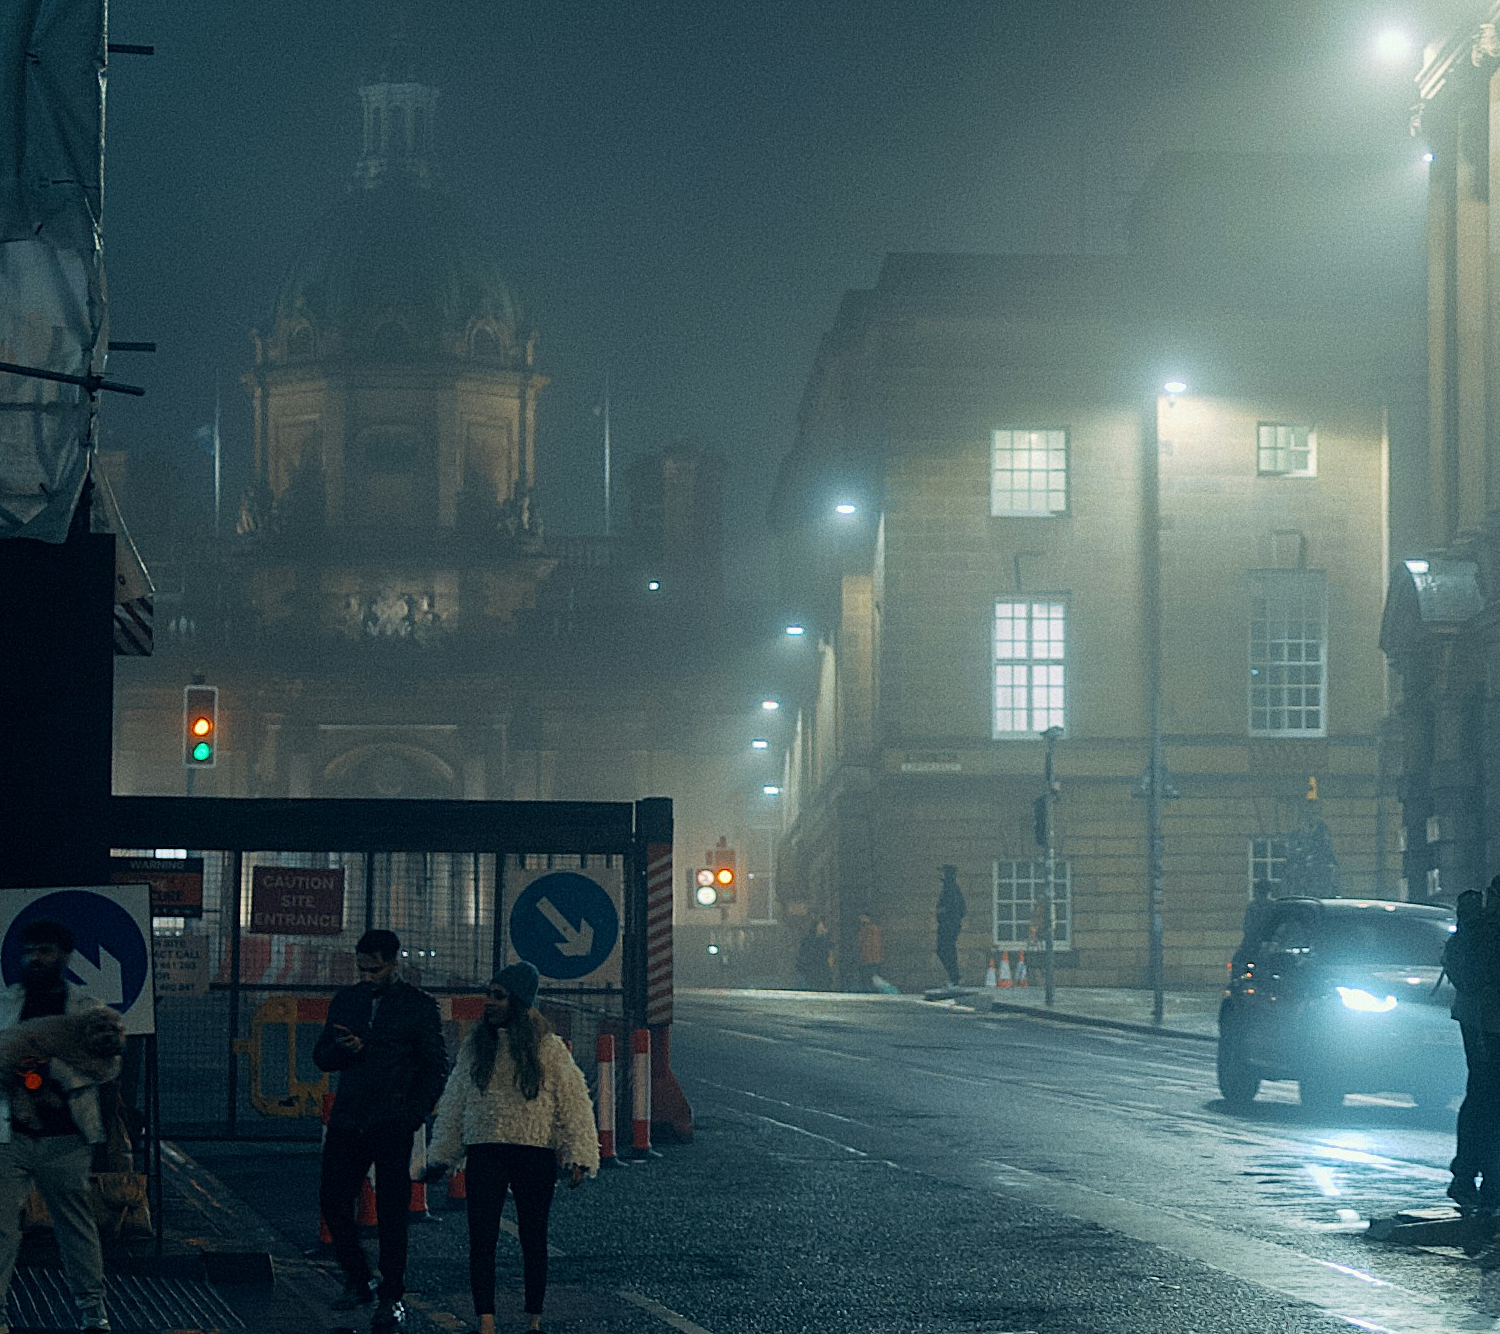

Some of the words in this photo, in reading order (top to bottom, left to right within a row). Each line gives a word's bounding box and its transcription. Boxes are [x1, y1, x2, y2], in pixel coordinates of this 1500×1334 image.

[261, 875, 335, 890] CAUTION
[281, 895, 315, 908] SITE
[255, 914, 339, 929] ENTRANCE
